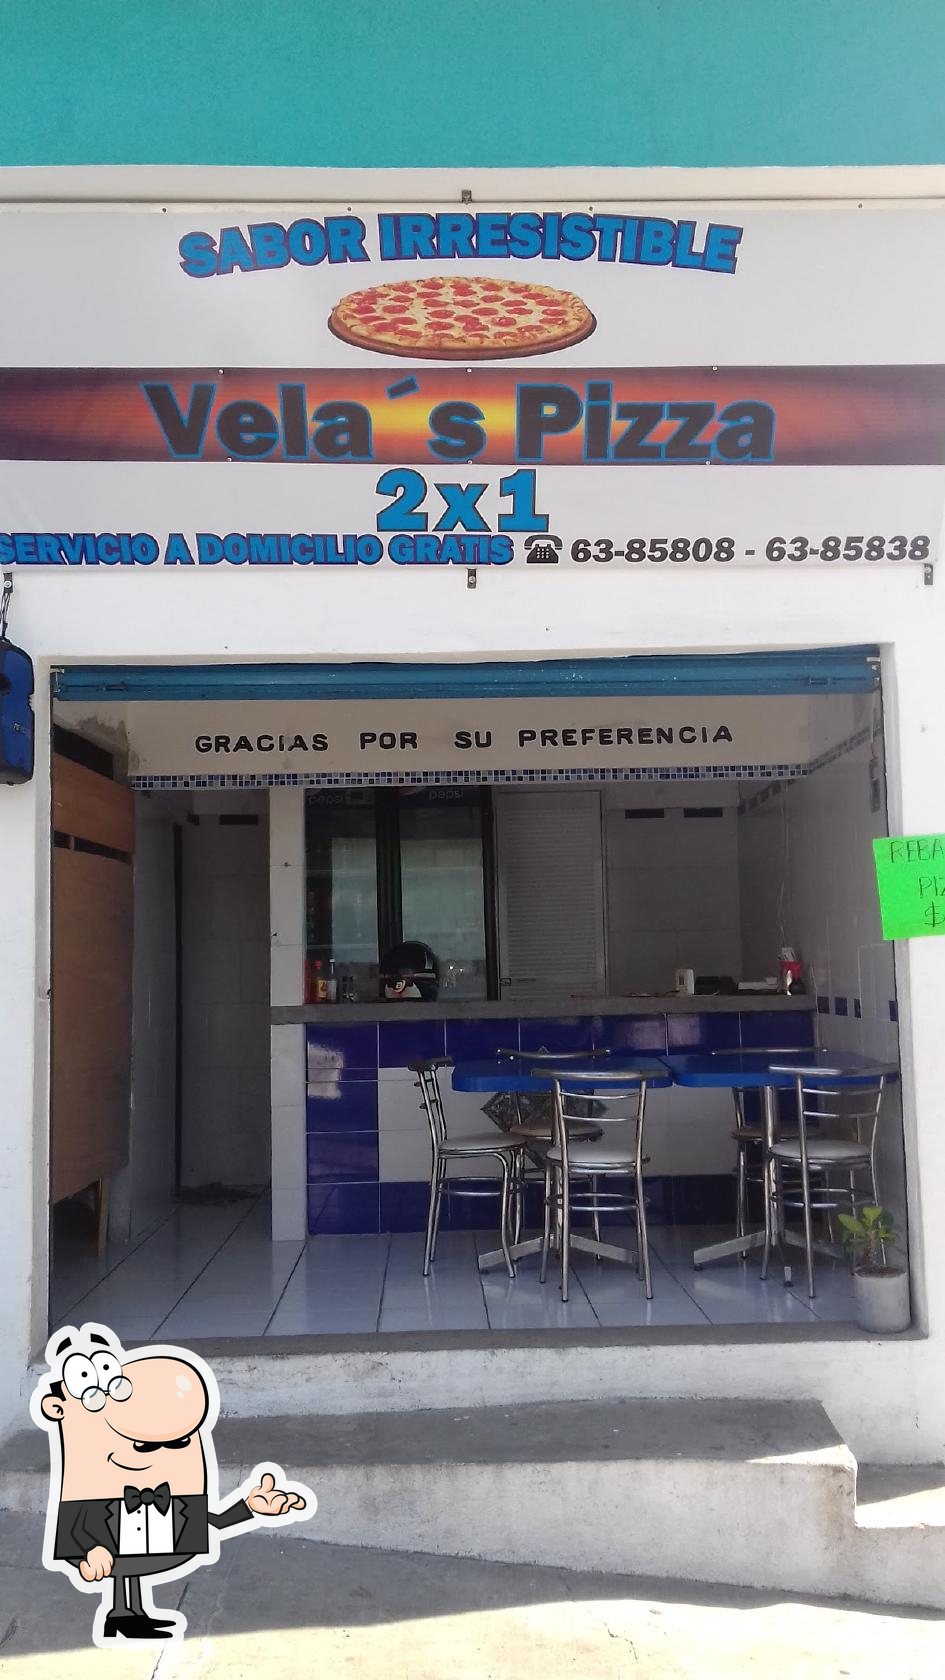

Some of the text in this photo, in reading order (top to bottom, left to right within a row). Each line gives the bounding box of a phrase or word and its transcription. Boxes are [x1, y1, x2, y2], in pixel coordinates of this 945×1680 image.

[179, 211, 744, 279] SABOR IRRESISTIBLE
[514, 380, 777, 462] Pizza
[375, 467, 549, 533] 2x1
[0, 532, 160, 565] SERVICIO
[163, 532, 195, 566] A
[195, 532, 384, 566] DOMICILIO
[388, 533, 515, 566] GRATIS
[570, 536, 735, 563] 63-85808
[765, 534, 930, 562] 63-85838
[195, 725, 733, 753] GRACIAS POR SU PREFERENCIA
